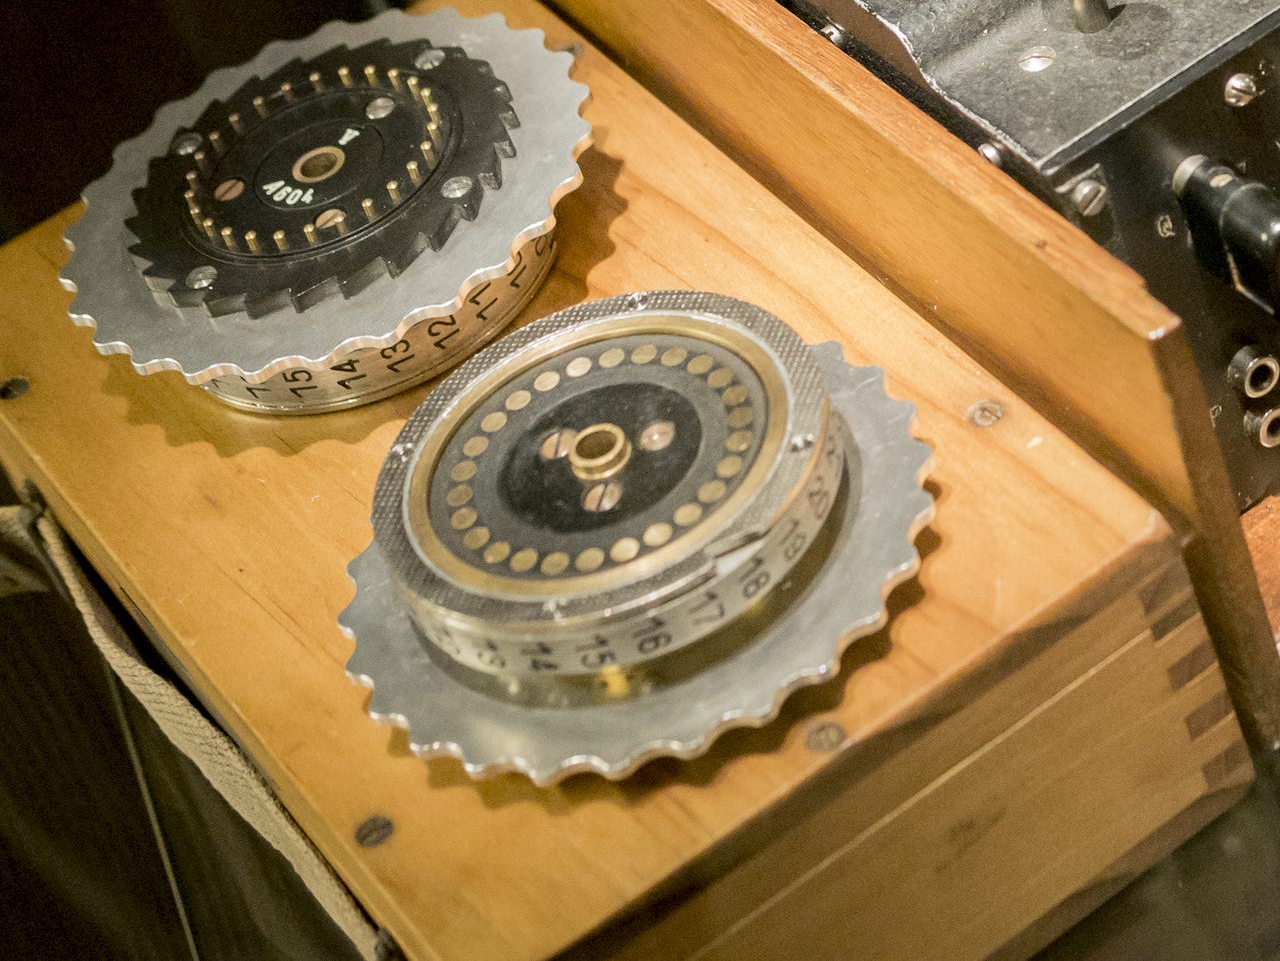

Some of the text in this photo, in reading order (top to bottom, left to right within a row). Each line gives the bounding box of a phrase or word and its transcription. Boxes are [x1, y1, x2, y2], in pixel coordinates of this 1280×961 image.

[262, 180, 314, 205] A604
[1157, 213, 1175, 238] Q
[469, 282, 498, 321] 11
[427, 315, 460, 349] 12
[380, 339, 415, 373] 13
[282, 369, 318, 400] 15
[330, 358, 367, 389] 14
[740, 558, 770, 599] 18
[689, 591, 725, 625] 17
[632, 616, 672, 654] 16
